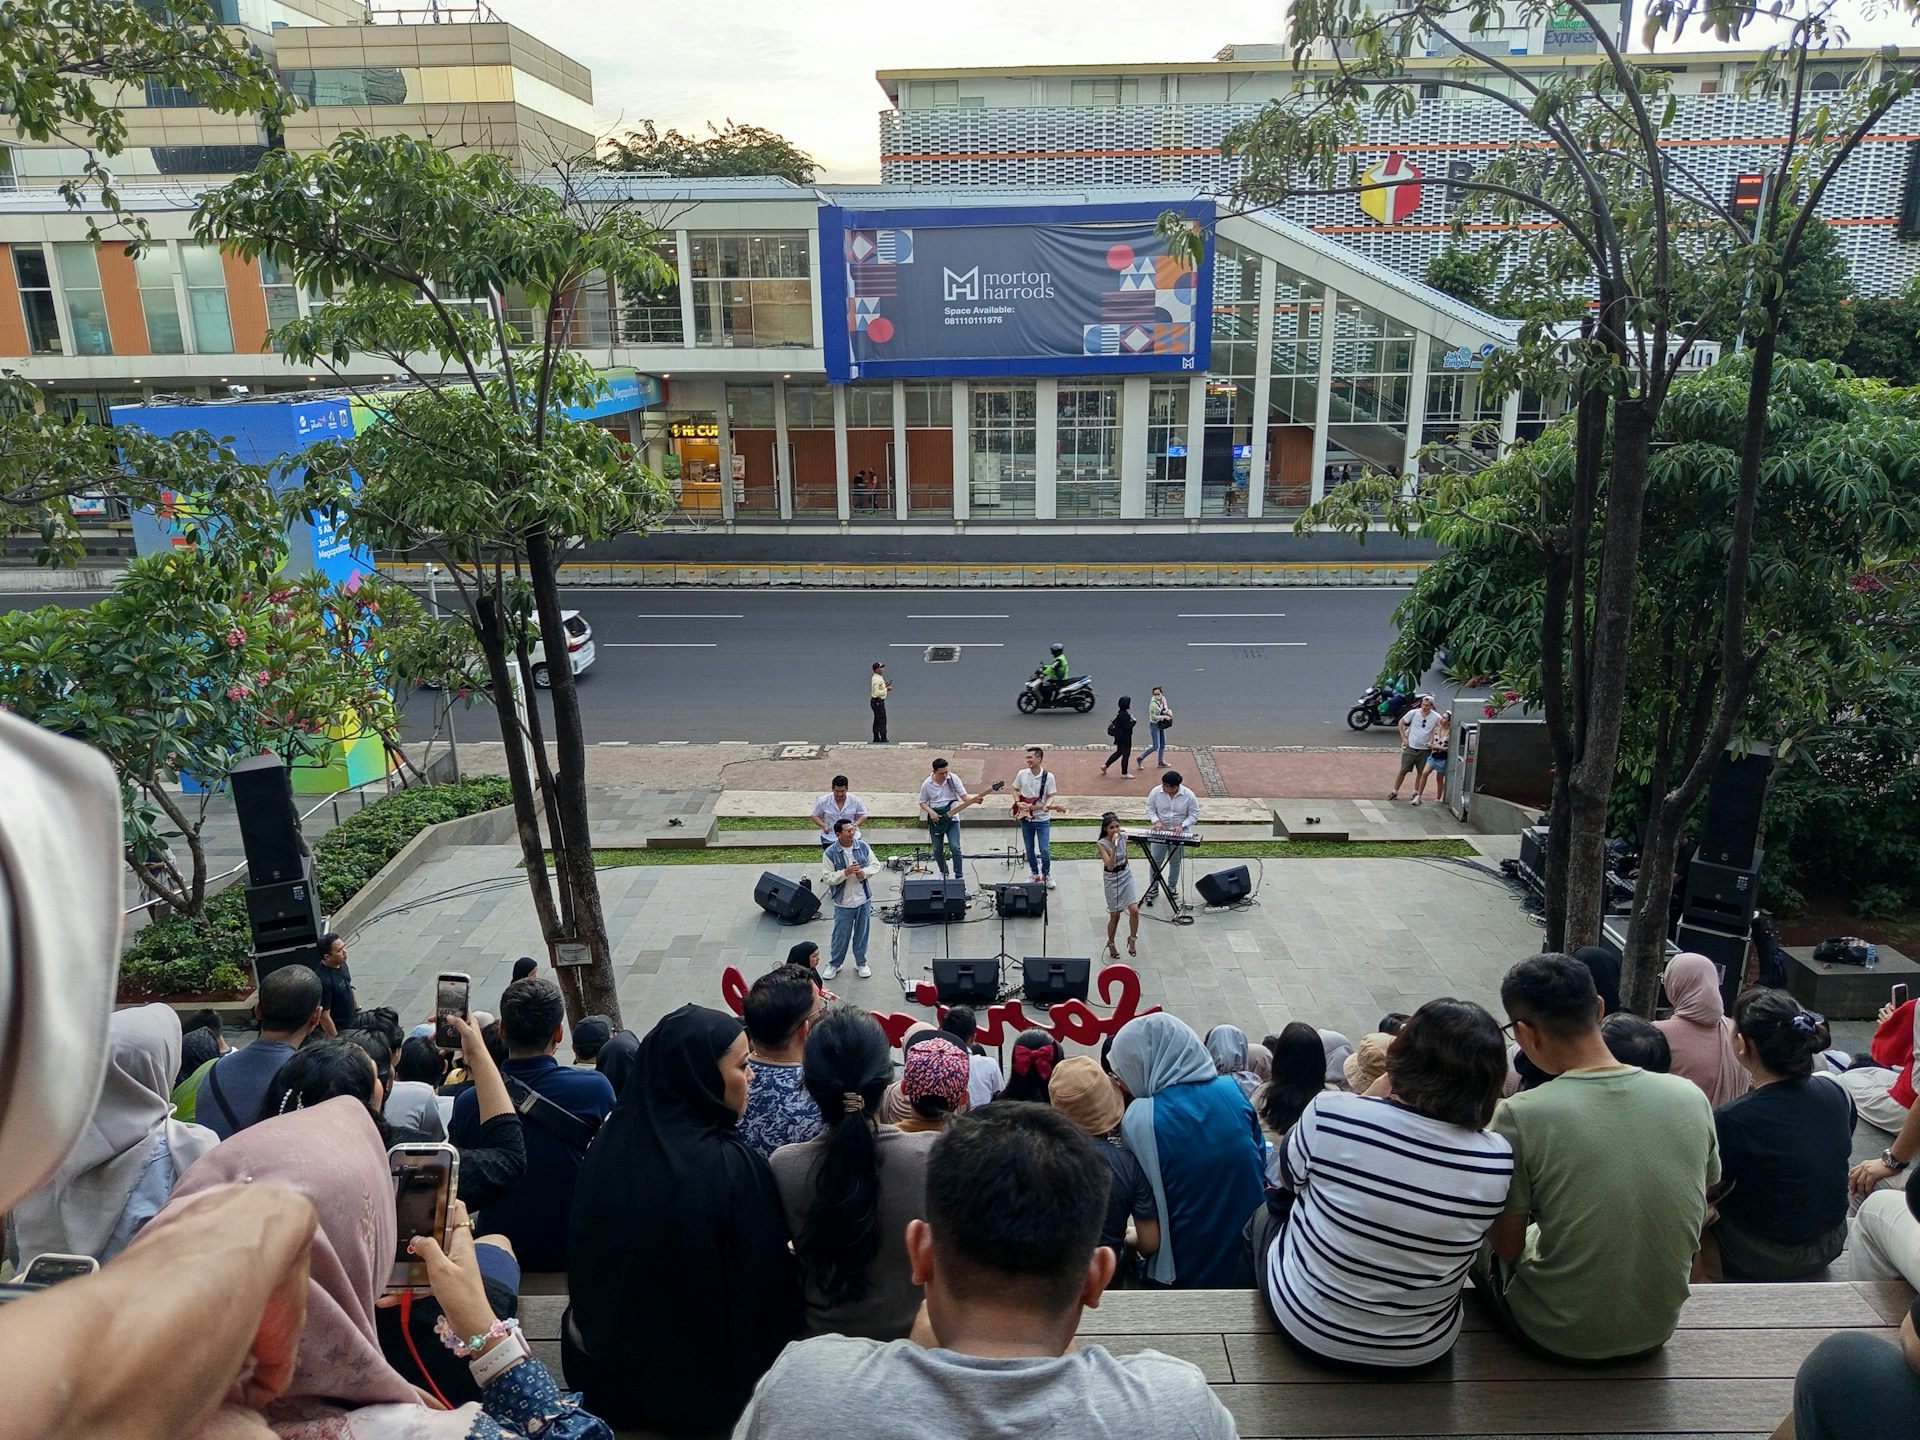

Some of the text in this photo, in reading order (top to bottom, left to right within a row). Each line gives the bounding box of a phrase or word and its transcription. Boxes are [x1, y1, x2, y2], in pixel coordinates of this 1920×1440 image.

[1544, 30, 1596, 46] Express
[983, 271, 1050, 285] morton
[983, 282, 1054, 300] harrods
[944, 306, 1015, 316] Space Available:
[944, 316, 1002, 325] 081110111976
[1445, 353, 1459, 361] Jak
[1444, 359, 1470, 368] Lingko
